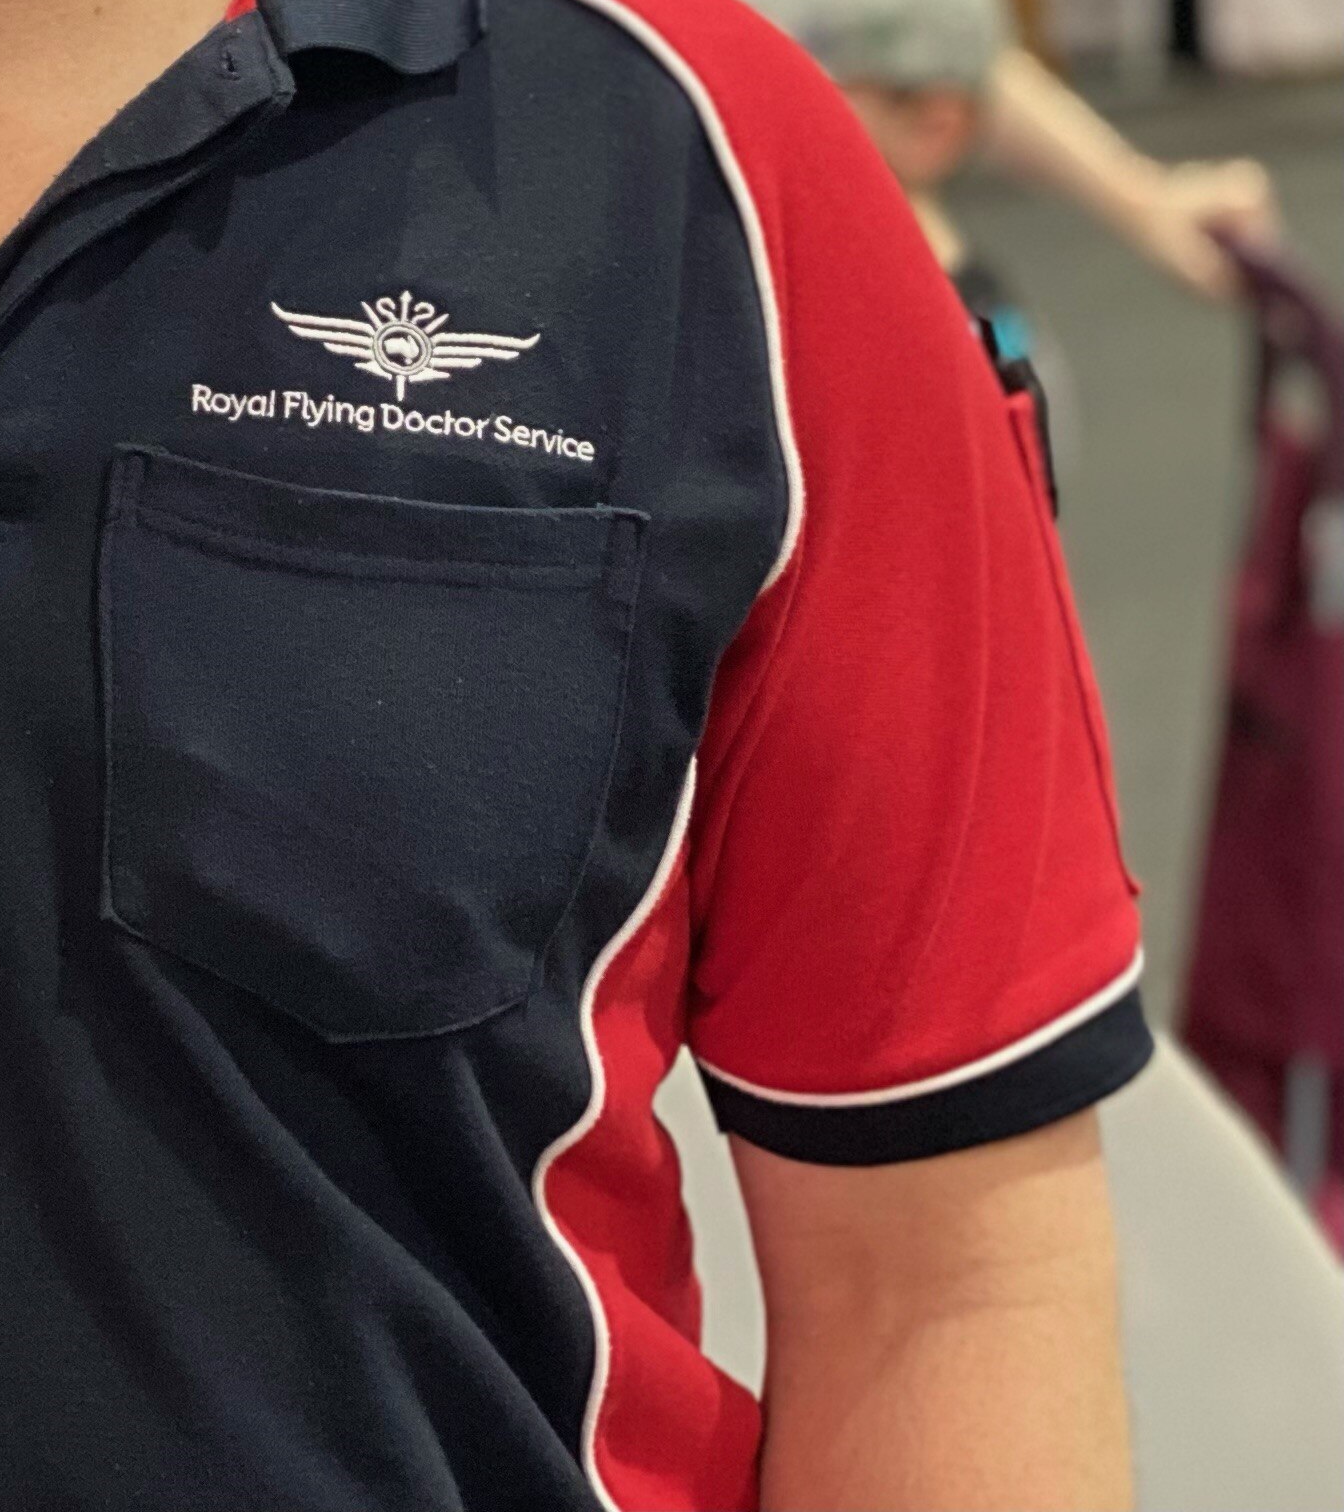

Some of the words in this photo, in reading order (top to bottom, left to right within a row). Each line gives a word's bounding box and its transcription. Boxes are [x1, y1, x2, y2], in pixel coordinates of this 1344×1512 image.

[191, 383, 276, 422] Royal
[283, 390, 375, 433] Flying
[380, 402, 490, 440] Doctor
[493, 415, 596, 462] Service
